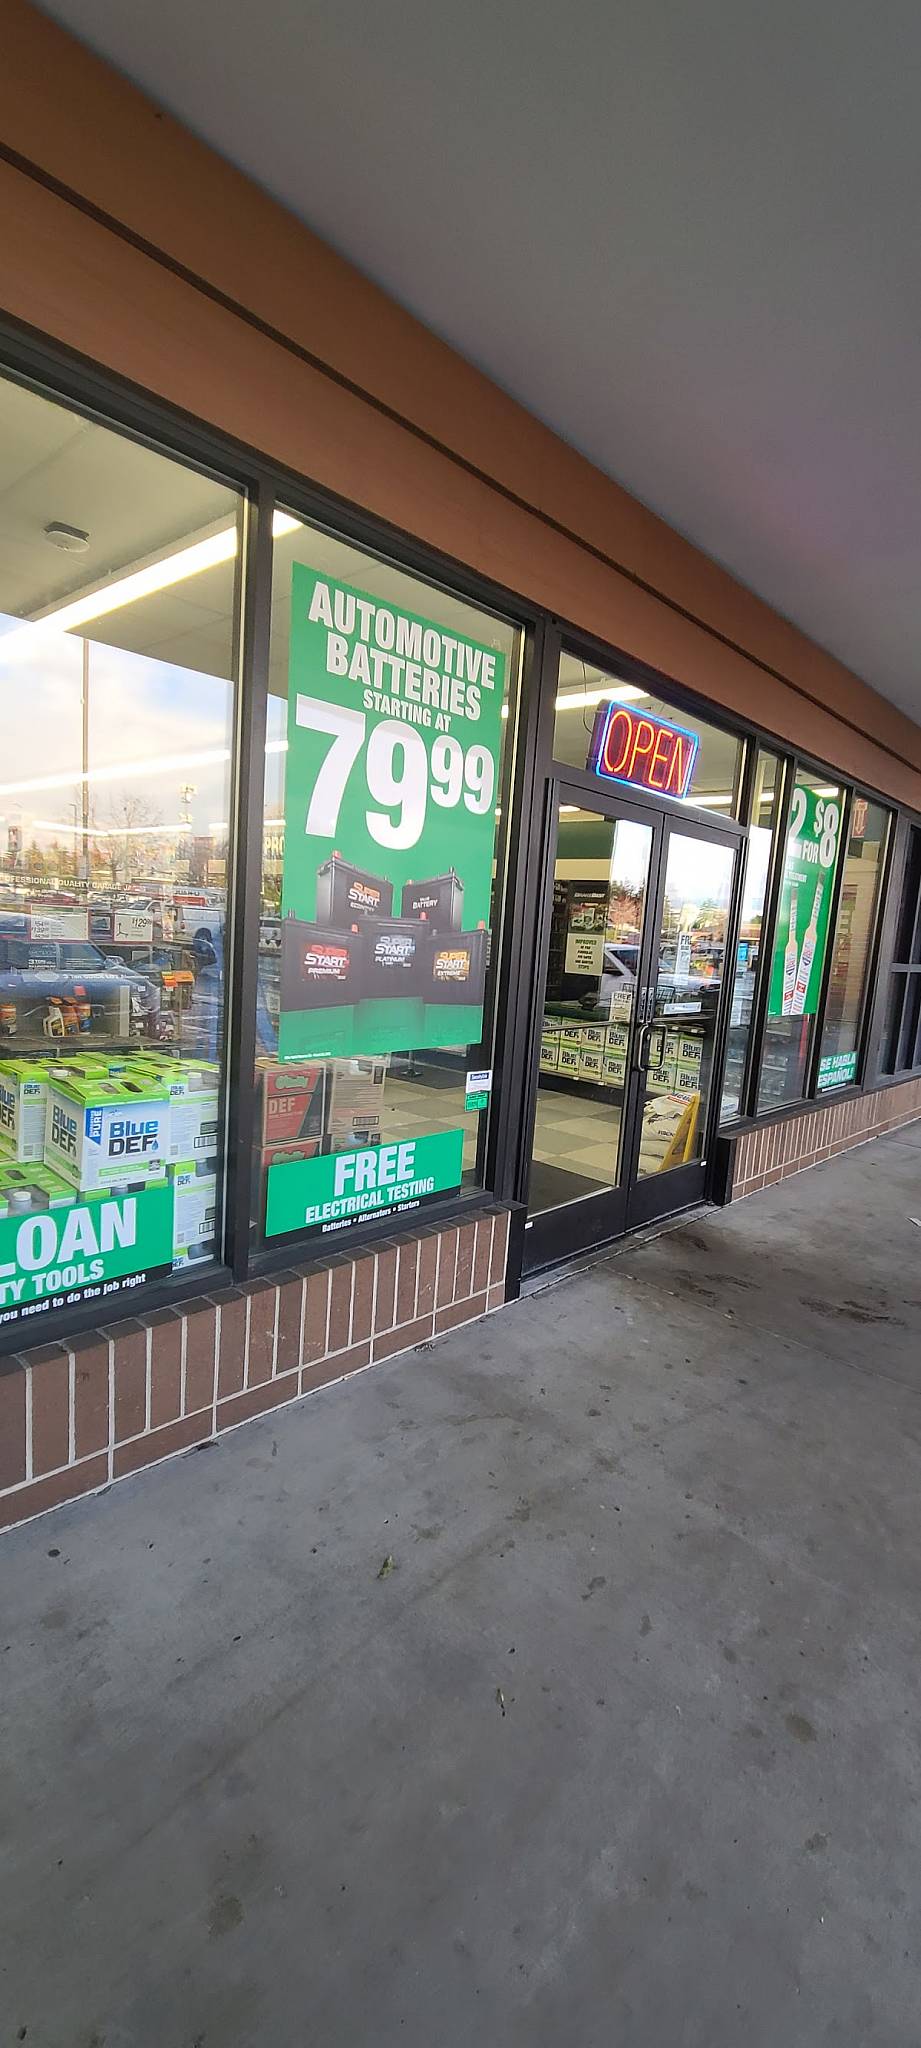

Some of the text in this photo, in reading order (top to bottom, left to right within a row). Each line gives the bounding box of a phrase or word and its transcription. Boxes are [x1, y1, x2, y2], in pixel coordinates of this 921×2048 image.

[308, 580, 496, 690] AUTOMOTIVE
[326, 631, 482, 721] BATTERIES
[363, 690, 452, 733] STARTING AT
[603, 710, 693, 795] OPEN
[787, 788, 839, 868] 2 FOR $8
[348, 888, 381, 907] START
[412, 900, 438, 909] BATTERY
[303, 953, 347, 968] START
[374, 943, 411, 957] START
[435, 958, 466, 970] START
[820, 1052, 856, 1071] SE HABLA
[0, 1084, 16, 1109] lue
[268, 1098, 296, 1115] DEF
[1, 1104, 15, 1131] EF
[53, 1104, 78, 1135] Blue
[93, 1110, 103, 1137] PURE
[109, 1120, 159, 1139] Blue
[51, 1123, 77, 1154] DEF
[108, 1133, 159, 1157] DEF
[333, 1142, 416, 1198] FREE
[305, 1177, 435, 1224] ELECTRICAL TESTING
[322, 1200, 420, 1233] Batteries Alternators Starters
[32, 1258, 105, 1295] TOOLS
[0, 1273, 146, 1326] you need to do the job right
